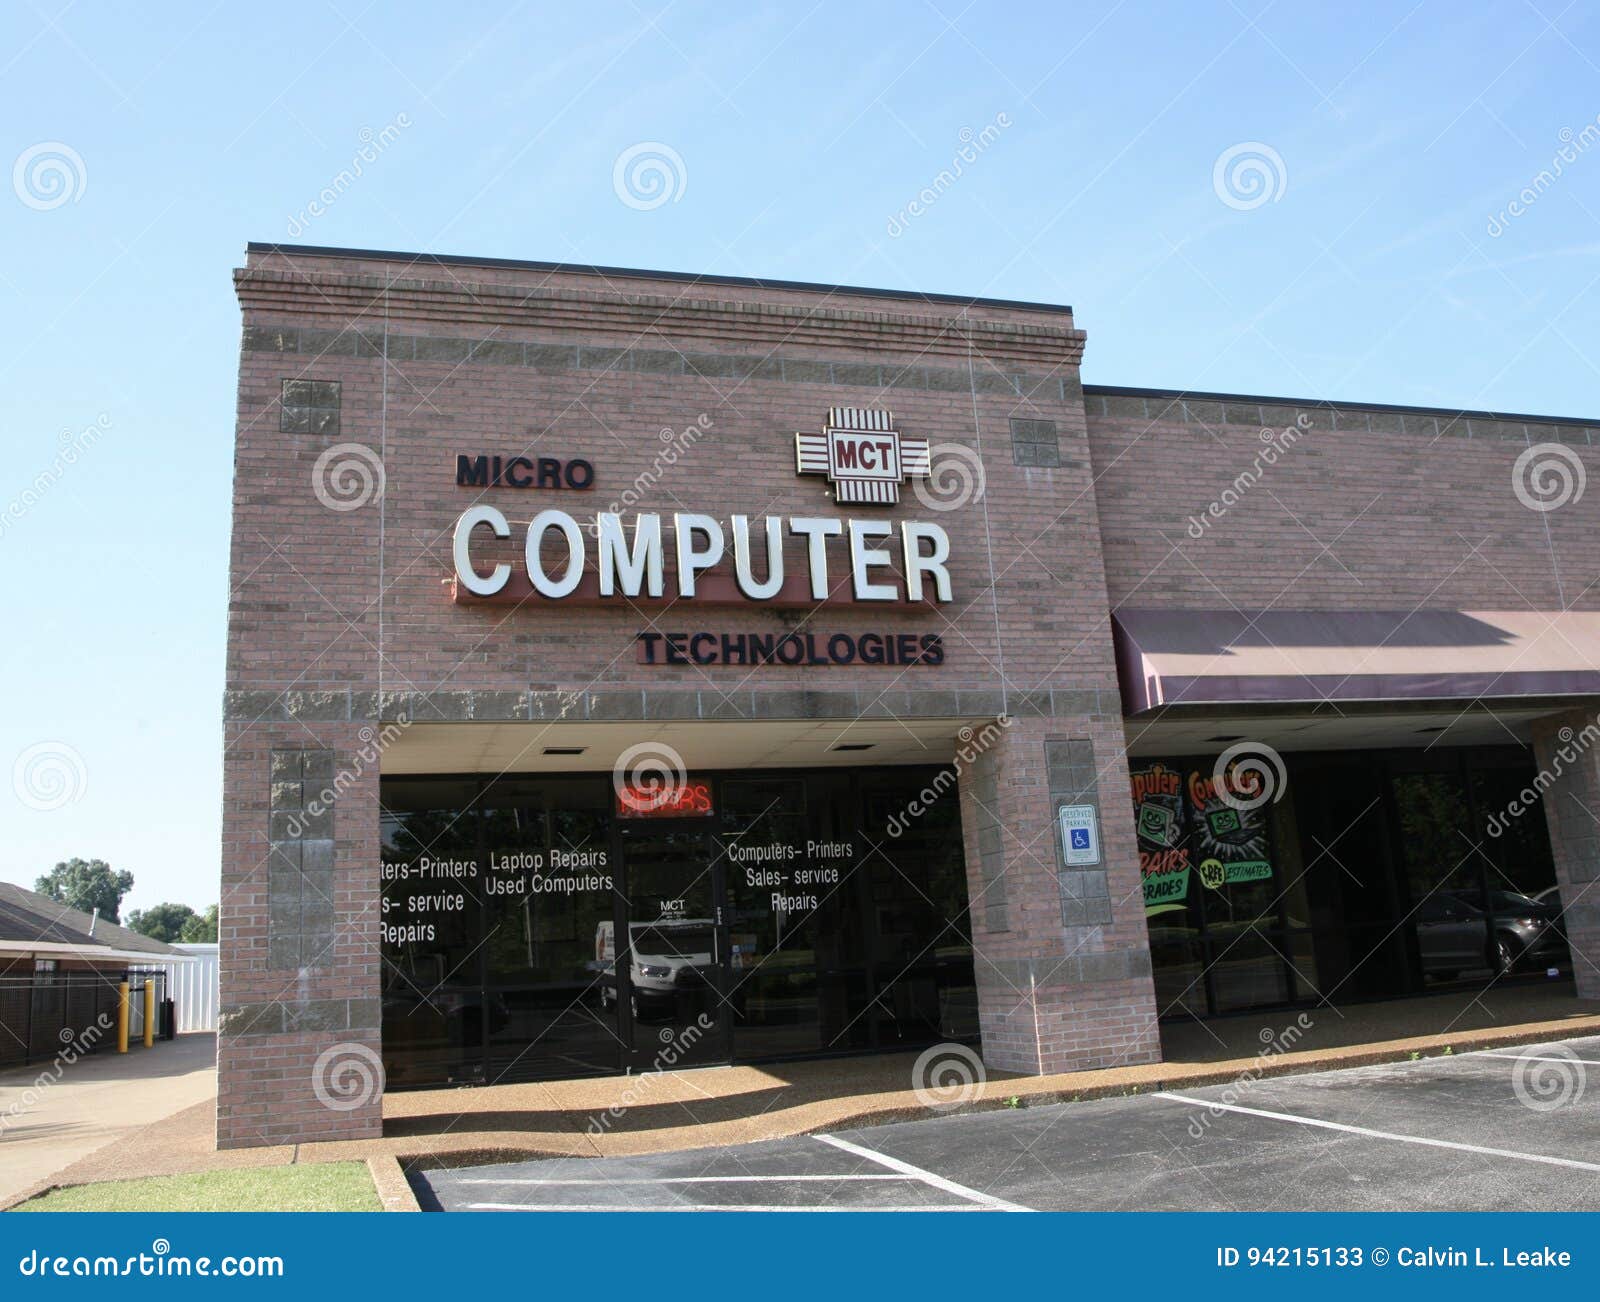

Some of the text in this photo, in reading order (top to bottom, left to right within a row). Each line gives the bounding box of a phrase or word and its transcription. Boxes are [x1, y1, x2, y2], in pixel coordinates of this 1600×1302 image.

[836, 440, 892, 470] MCT
[457, 454, 595, 490] MICRO
[453, 505, 953, 602] COMPUTER
[636, 632, 945, 665] TECHNOLOGIES
[1130, 766, 1179, 805] puter
[490, 848, 607, 873] Laptop Repairs
[807, 840, 853, 858] Printers
[794, 865, 839, 885] service
[1226, 865, 1270, 879] ESTIMATES
[485, 874, 613, 896] Used Computers
[408, 889, 464, 912] service
[660, 900, 685, 911] MCT
[771, 891, 818, 915] Repairs
[380, 920, 435, 948] Repairs
